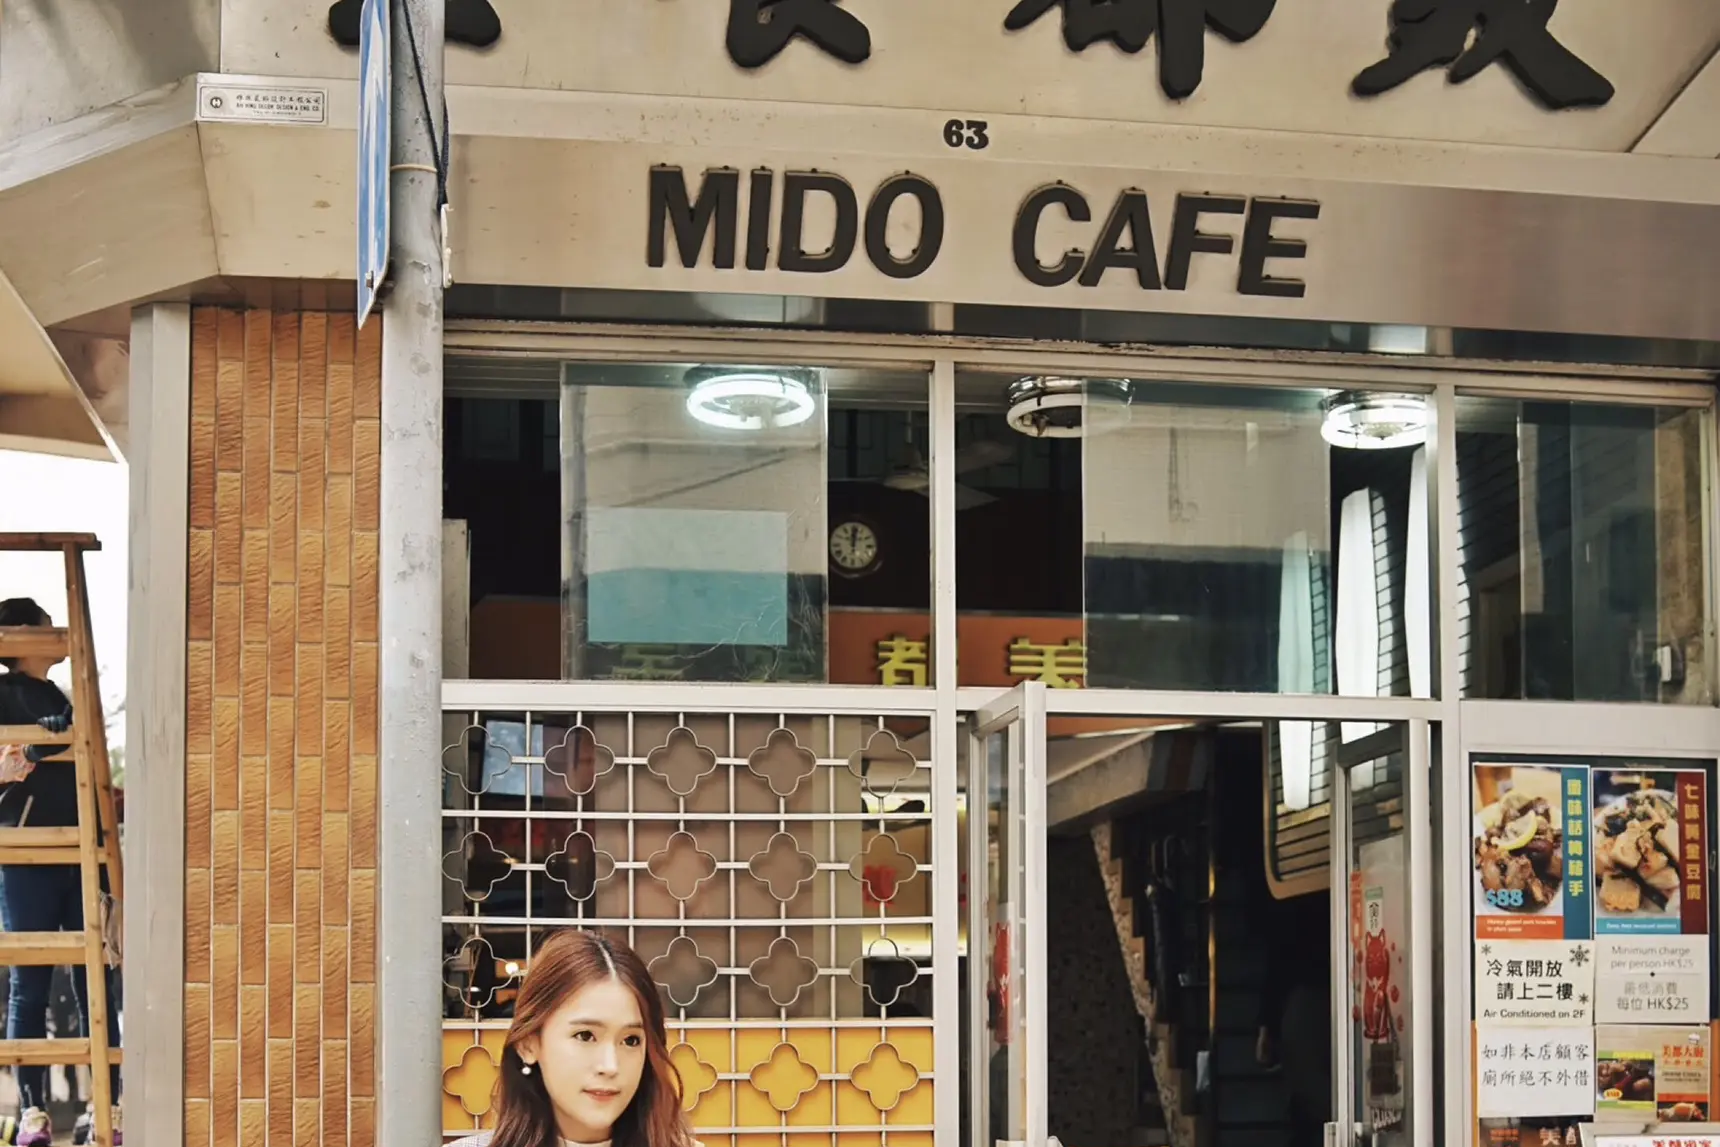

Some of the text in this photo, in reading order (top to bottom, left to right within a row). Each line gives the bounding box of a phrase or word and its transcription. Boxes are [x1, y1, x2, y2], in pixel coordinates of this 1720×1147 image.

[943, 119, 988, 148] 63
[646, 163, 1321, 298] MIDO CAFE
[1611, 946, 1691, 956] Minimum charge
[1486, 958, 1563, 978] 冷氣開放
[1611, 961, 1629, 970] per
[1629, 960, 1661, 970] person
[1497, 982, 1574, 1001] 請上二樓
[1647, 996, 1690, 1010] HK$25
[1484, 1009, 1498, 1017] Air
[1500, 1009, 1556, 1018] Conditioned
[1573, 1009, 1586, 1018] 2F
[1482, 1043, 1590, 1060] 如非本店顧客
[1482, 1068, 1589, 1087] 廁所絕不外借
